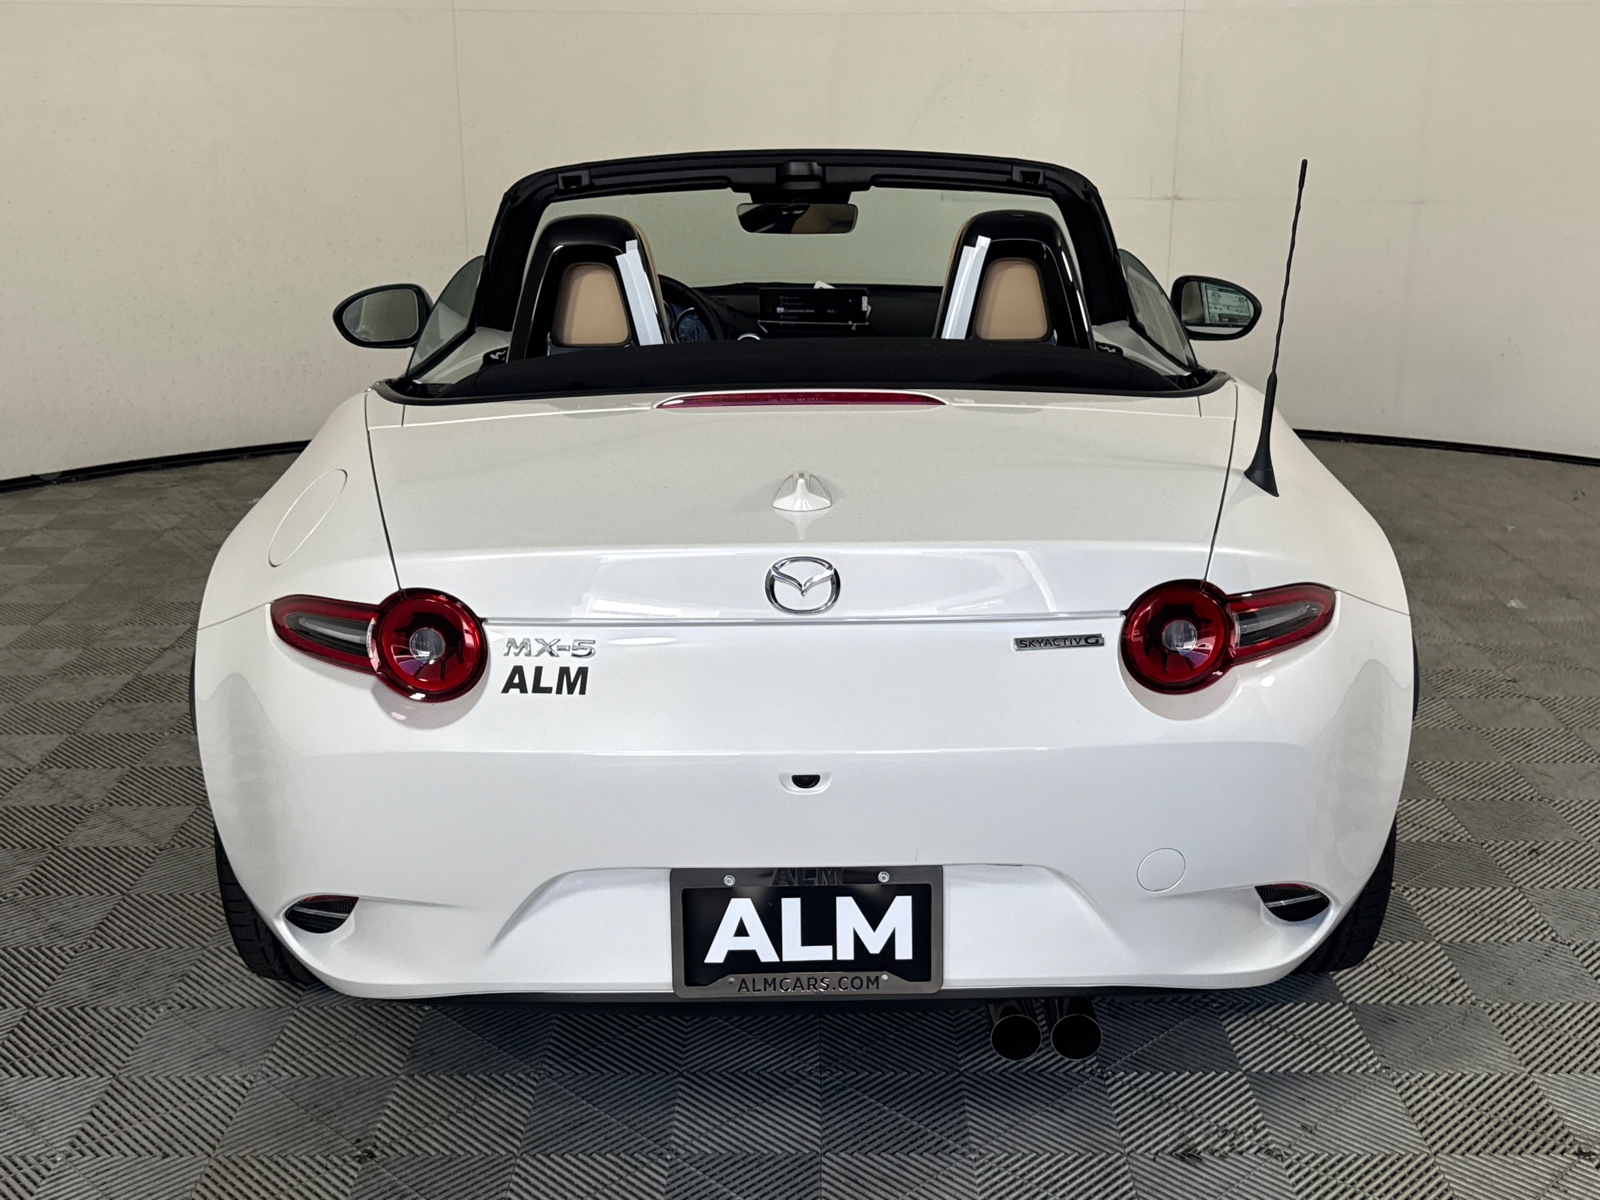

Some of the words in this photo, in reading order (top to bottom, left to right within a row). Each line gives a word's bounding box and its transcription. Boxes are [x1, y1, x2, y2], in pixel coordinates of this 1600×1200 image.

[503, 638, 596, 658] MX-5
[501, 665, 589, 695] ALM
[770, 867, 843, 887] ALM
[703, 895, 913, 964] ALM
[737, 975, 880, 993] ALMCARS.COM
